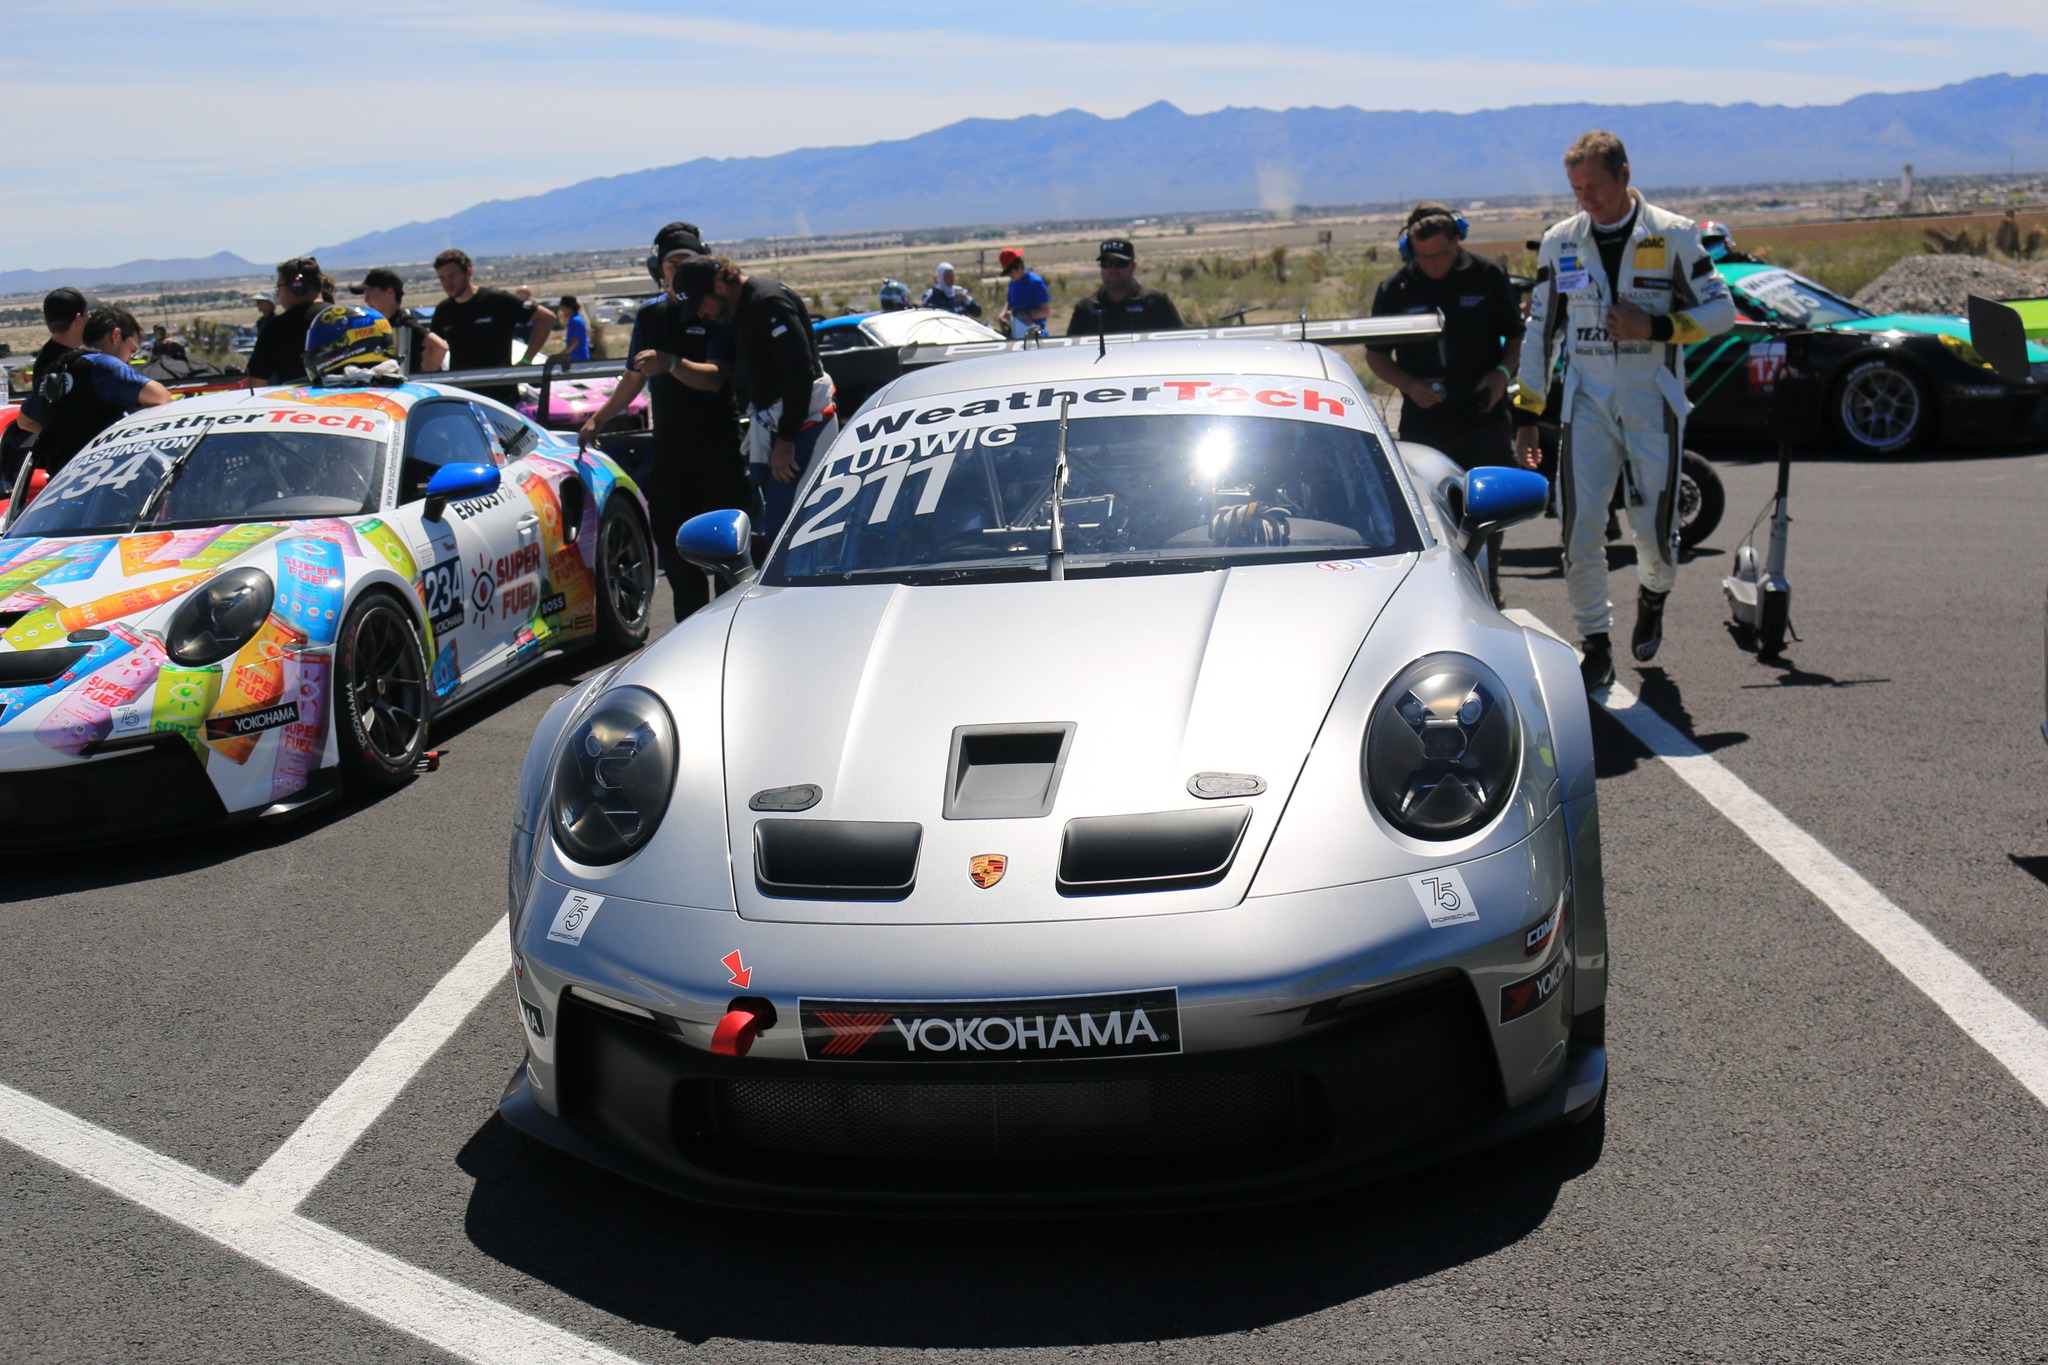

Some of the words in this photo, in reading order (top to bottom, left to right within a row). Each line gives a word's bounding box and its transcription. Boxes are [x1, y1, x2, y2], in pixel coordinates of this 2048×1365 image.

[91, 410, 376, 449] WeatherTech
[855, 381, 1346, 444] WeatherTech
[62, 436, 195, 474] WASHINGTON
[820, 424, 1017, 484] LUDWIG
[30, 453, 151, 513] 234
[789, 453, 958, 550] 211
[283, 555, 339, 577] SUPER
[496, 542, 541, 587] SUPER
[425, 560, 464, 620] 234
[503, 581, 538, 620] FUEL
[542, 596, 564, 615] BOSS
[435, 614, 464, 635] YOKOHAMA
[82, 687, 120, 708] FUEL
[88, 675, 138, 700] SUPER
[117, 706, 140, 727] 75
[155, 719, 198, 739] SUPE
[235, 706, 297, 732] YOKOHAMA
[284, 722, 323, 739] SUPER
[345, 682, 368, 750] YOKOHAMA
[285, 734, 313, 753] FUEL
[1421, 876, 1461, 911] 75
[562, 895, 589, 931] 75
[1430, 911, 1477, 924] PORSCHE
[549, 930, 580, 942] PORSCHE
[1537, 956, 1568, 999] YOKOH
[893, 1008, 1159, 1051] YOKOHAMA
